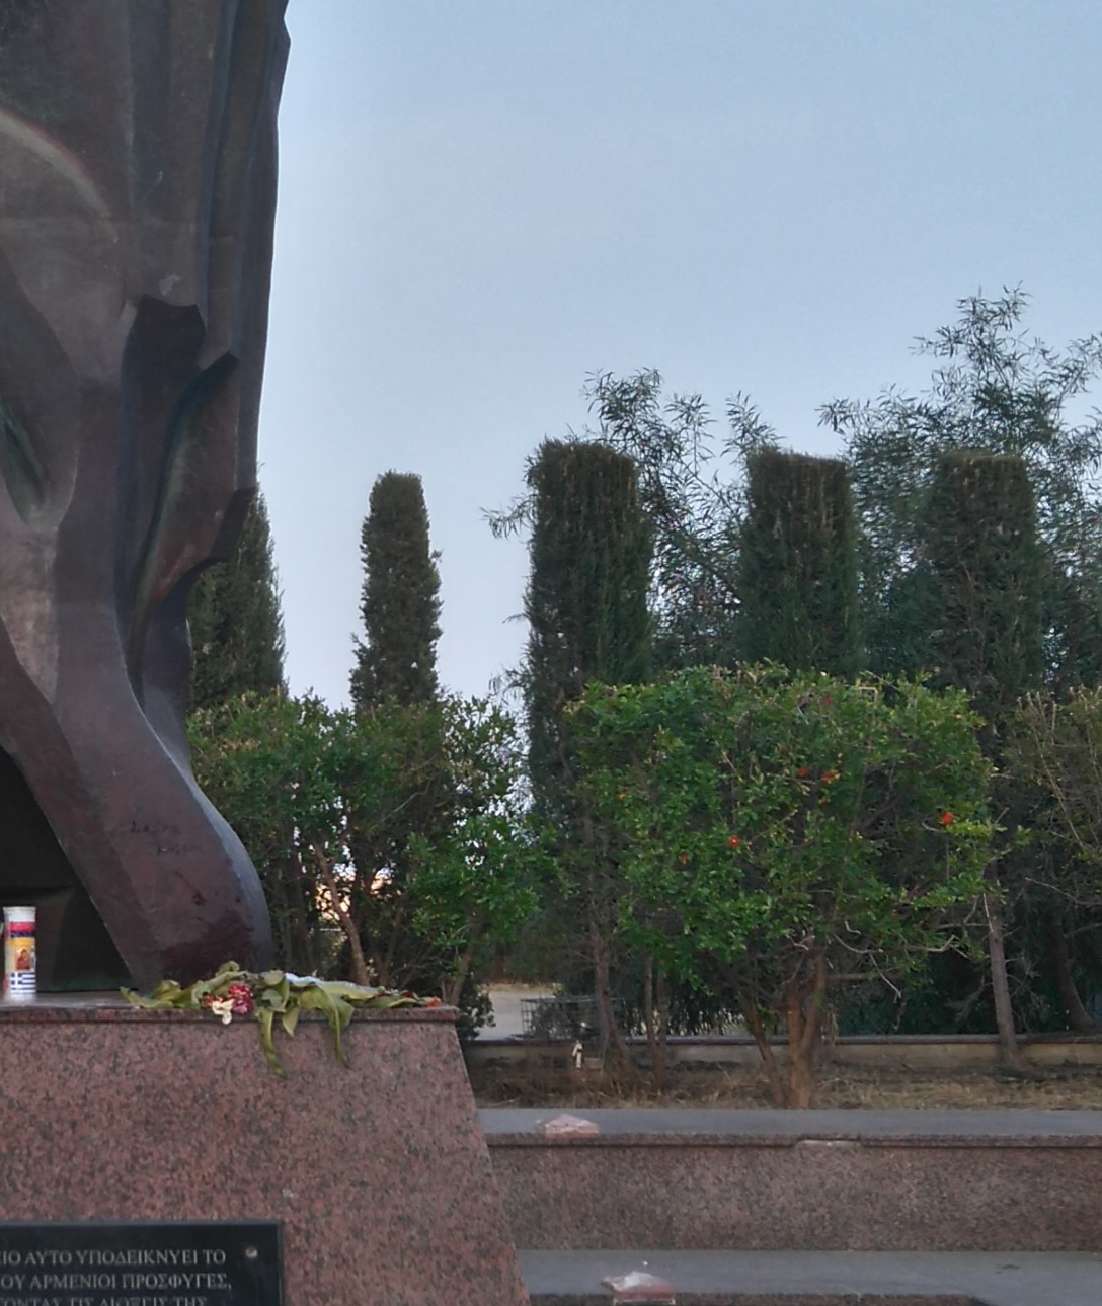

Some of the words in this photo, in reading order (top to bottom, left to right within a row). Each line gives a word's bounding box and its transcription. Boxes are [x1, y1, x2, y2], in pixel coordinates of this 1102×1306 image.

[24, 1249, 72, 1266] ΑΥΤΟ
[76, 1248, 198, 1266] ΥΠΟΔΕΙΚΝΥΕΙ
[203, 1248, 226, 1265] ΤΟ
[29, 1273, 116, 1291] ΑΡΜΕΝΙΟΙ
[123, 1273, 232, 1291] ΠΡΟΣΦΥΓΕΣ,
